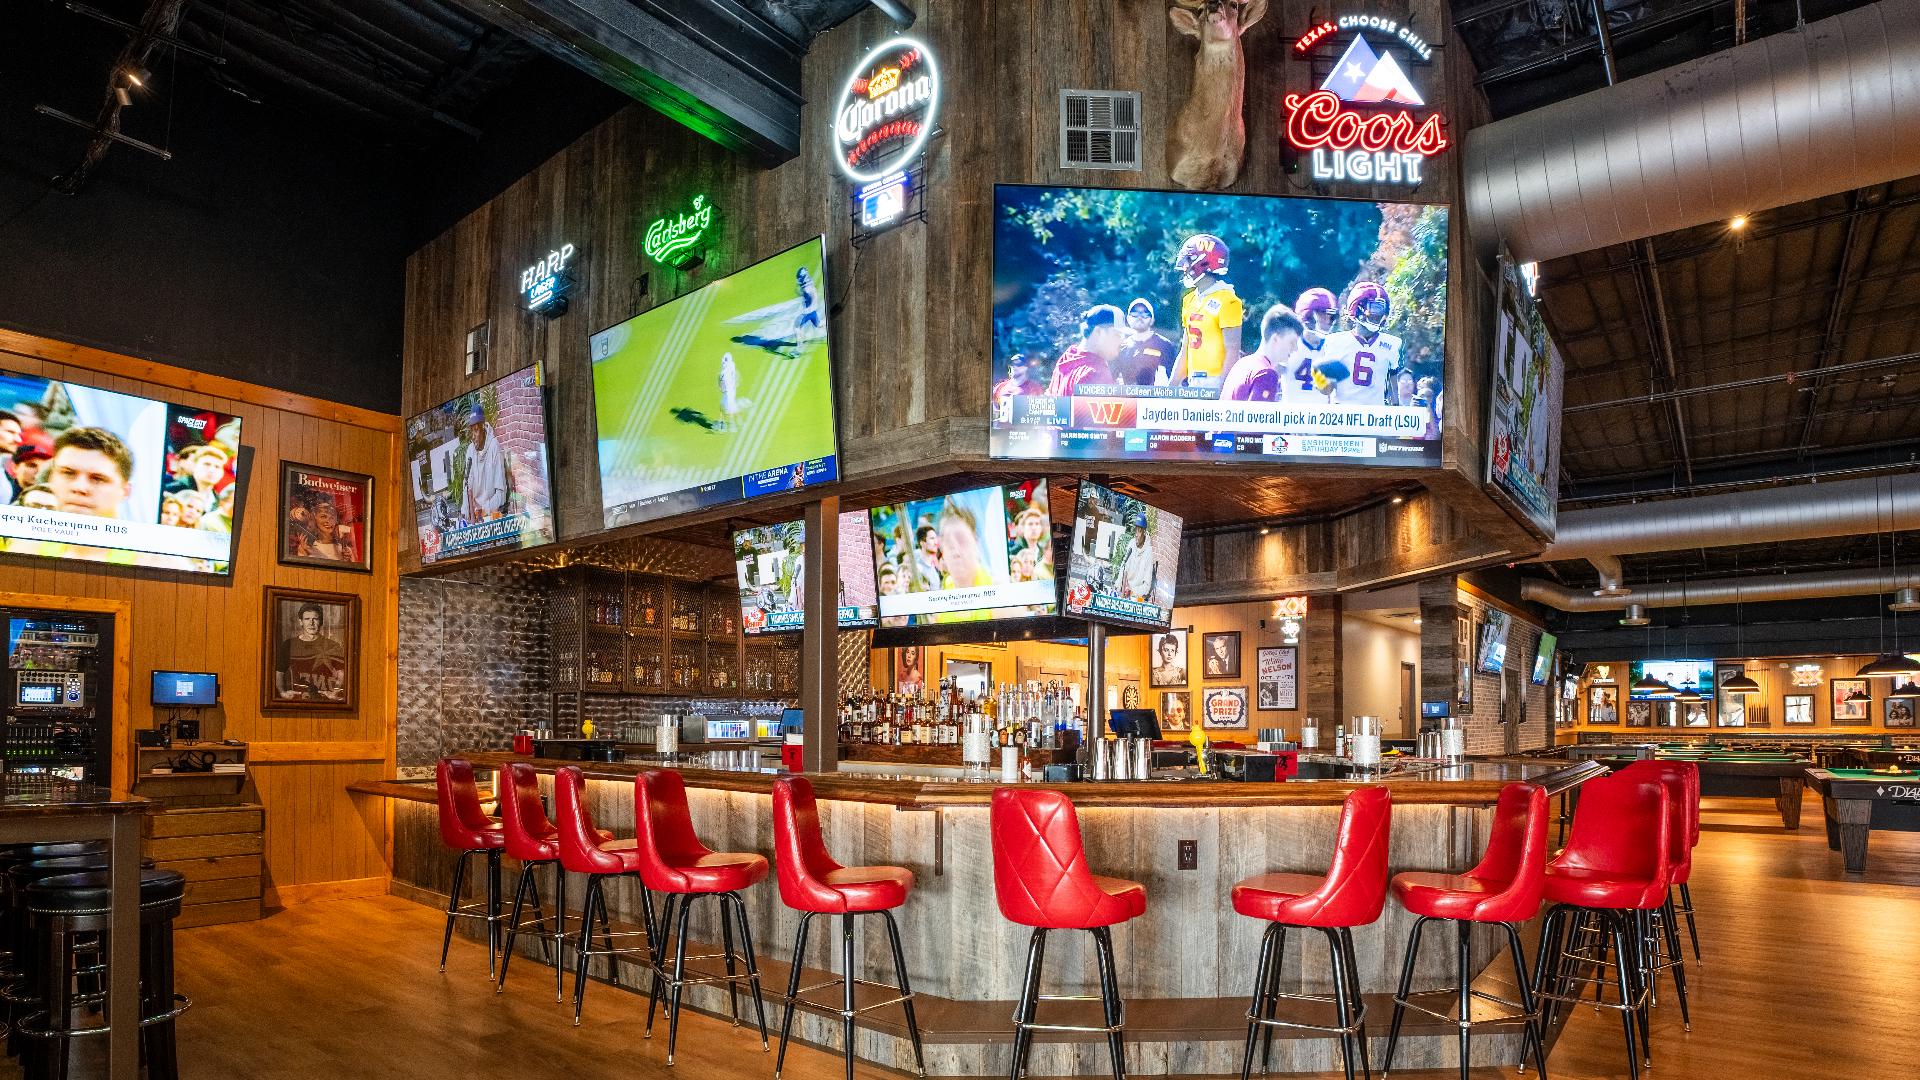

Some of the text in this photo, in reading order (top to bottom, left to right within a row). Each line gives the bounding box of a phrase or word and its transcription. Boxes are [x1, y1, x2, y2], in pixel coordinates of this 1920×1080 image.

[1296, 15, 1432, 61] TEXAS, CHOOSE CHILL
[838, 75, 932, 142] Corona
[1285, 90, 1447, 155] Coors
[1312, 149, 1423, 182] LIGHT
[645, 206, 711, 256] Carlsberg
[520, 243, 574, 294] HARP
[531, 277, 555, 298] LAGER
[1353, 351, 1376, 387] 6
[1078, 385, 1106, 395] VOICES
[1107, 386, 1118, 395] OF
[1179, 388, 1199, 397] David
[1200, 389, 1215, 398] Carr
[1142, 408, 1420, 431] Jayden Daniels: 2nd overall pick in 2024 NFL Draft (LSU)
[298, 473, 357, 493] Budweiser
[748, 474, 755, 482] IN
[755, 472, 766, 480] THE
[767, 467, 788, 477] ARENA
[32, 526, 52, 535] POLE
[105, 524, 128, 535] RUS
[1261, 662, 1292, 675] NELSON
[1791, 669, 1824, 685] XX
[1211, 699, 1239, 707] GRAND
[1213, 707, 1238, 715] PRIZE
